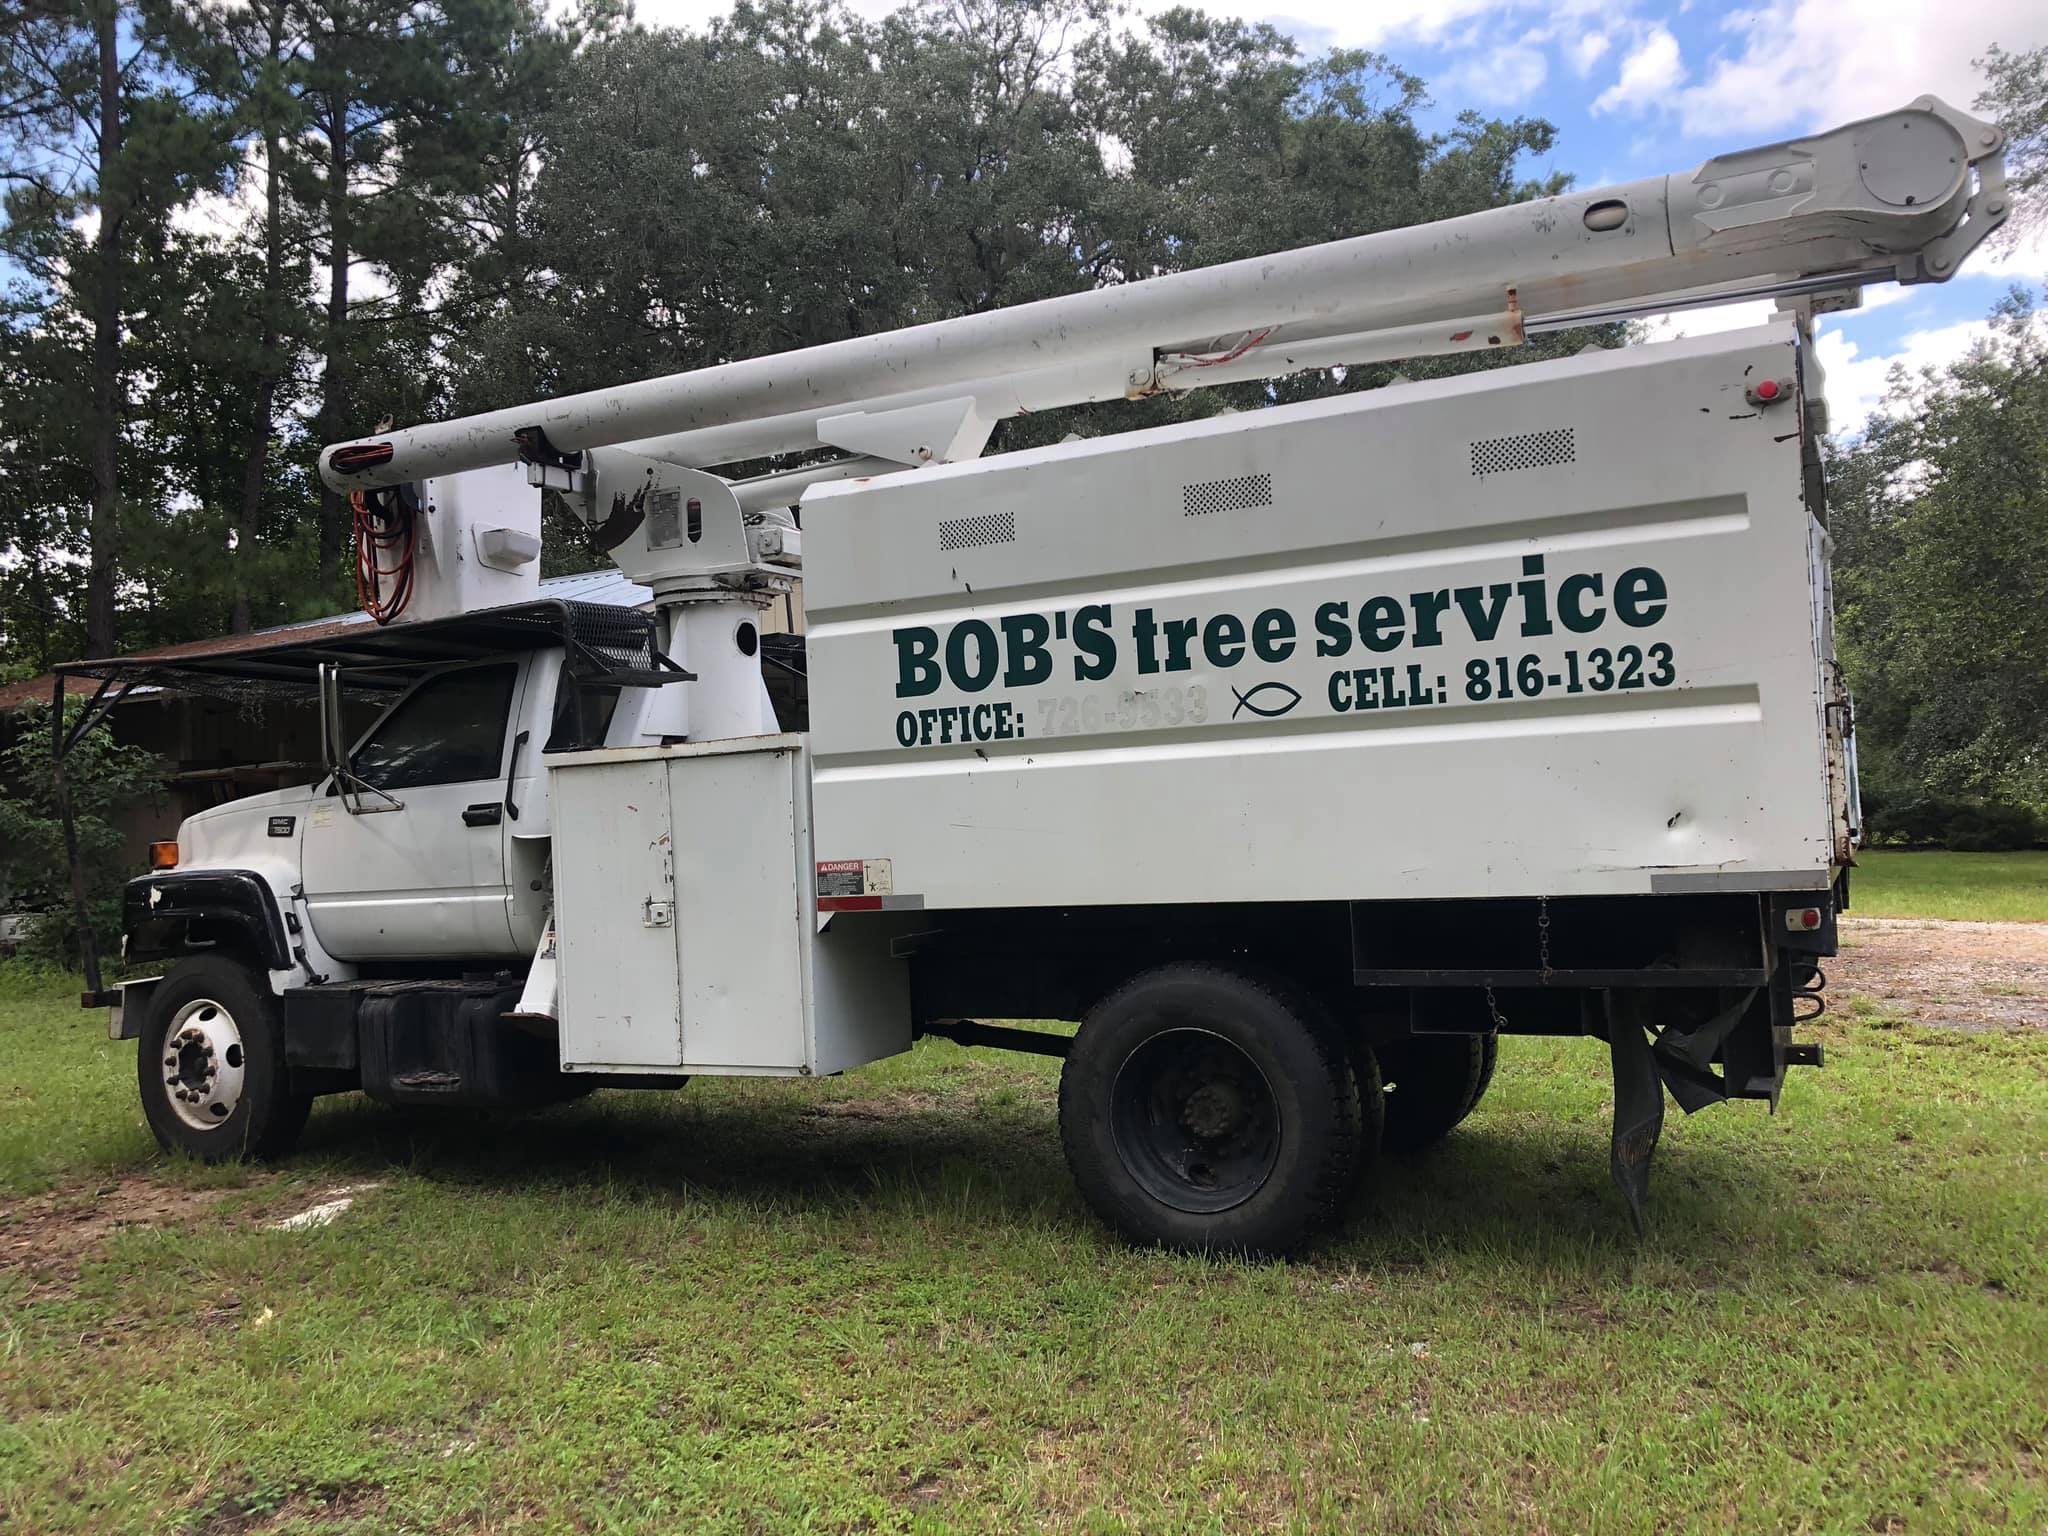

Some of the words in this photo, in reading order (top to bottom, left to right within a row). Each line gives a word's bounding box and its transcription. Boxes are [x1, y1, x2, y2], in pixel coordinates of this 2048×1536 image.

[892, 604, 1117, 699] BOB'S
[1132, 608, 1297, 675] tree
[1314, 553, 1668, 658] service
[1328, 664, 1448, 713] CELL:
[1465, 642, 1677, 702] 816-1323
[896, 702, 1025, 748] OFFICE:
[827, 862, 860, 872] DANGER
